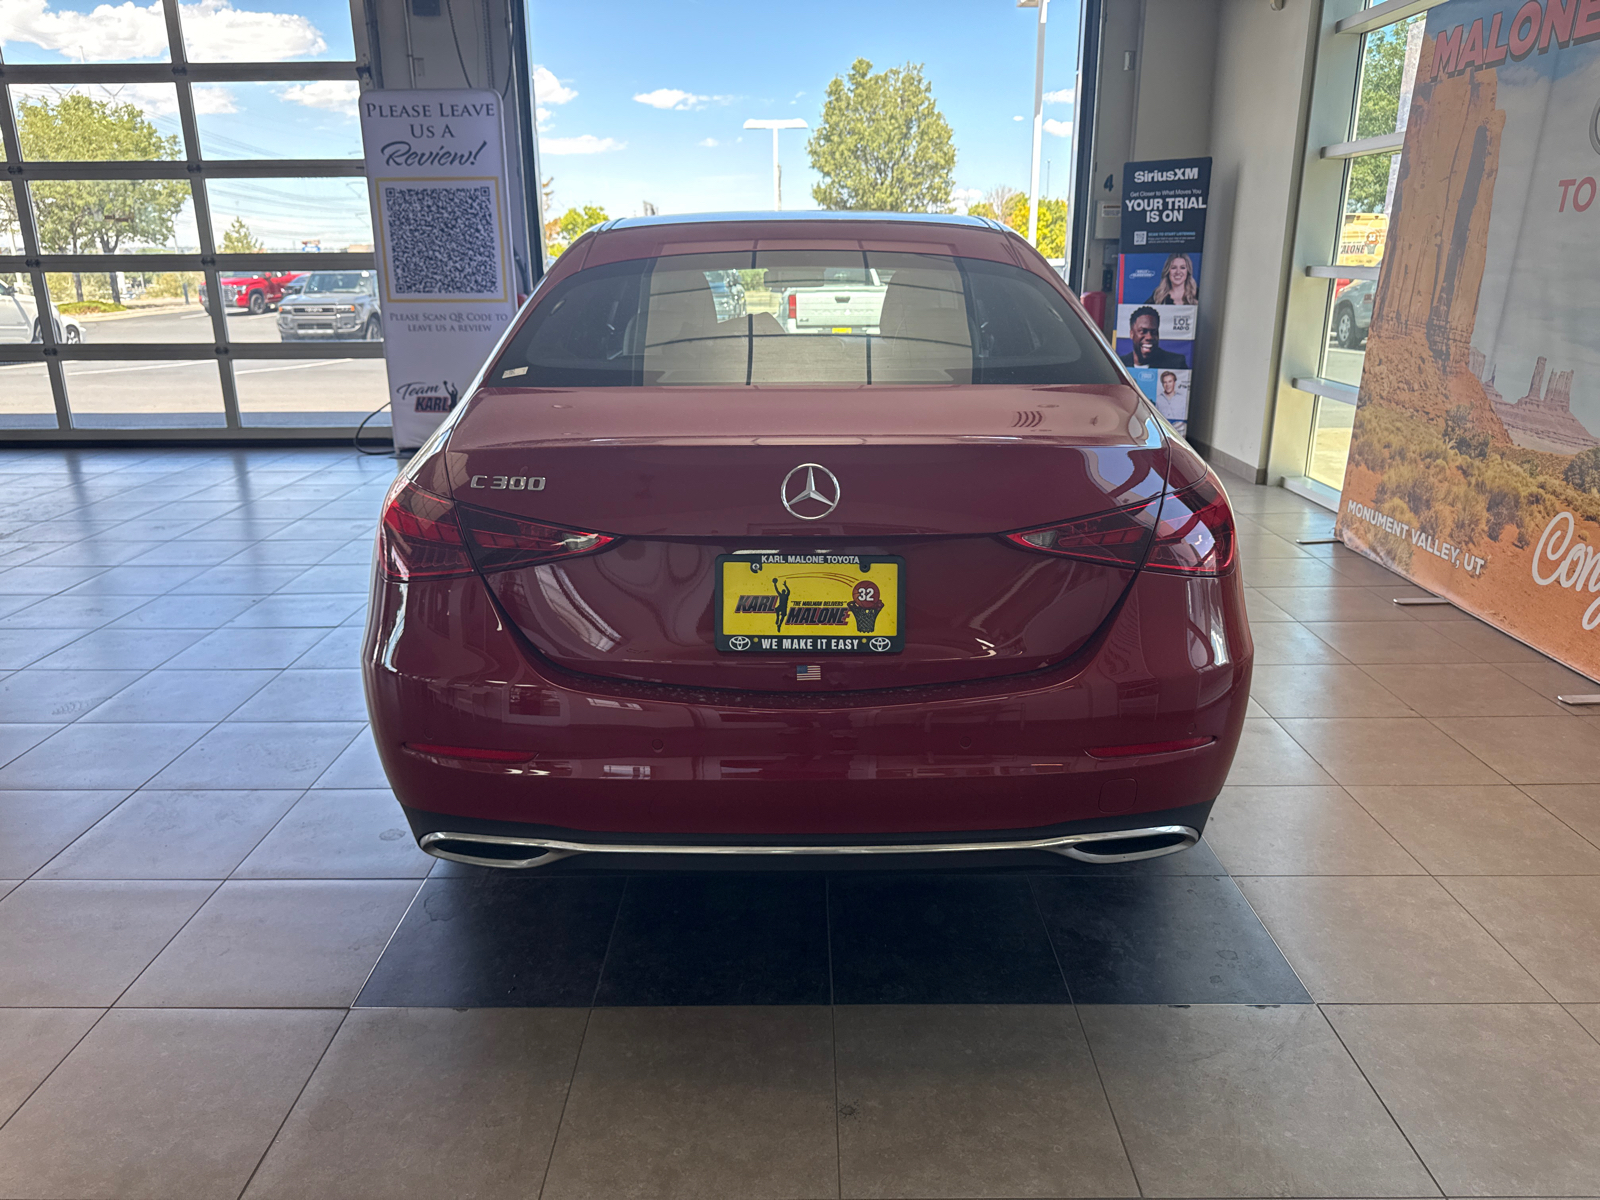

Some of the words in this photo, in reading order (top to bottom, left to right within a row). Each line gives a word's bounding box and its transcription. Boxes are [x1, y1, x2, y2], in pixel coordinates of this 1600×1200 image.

[366, 103, 432, 118] PLEASE
[439, 103, 495, 118] LEAVE
[441, 124, 456, 139] A
[380, 140, 488, 167] Review!
[1134, 167, 1199, 183] SiriusXM
[1103, 174, 1114, 192] 4
[1558, 176, 1597, 213] TO
[1125, 198, 1163, 212] YOUR
[1166, 196, 1207, 210] TRIAL
[1146, 210, 1160, 223] IS
[1162, 210, 1184, 222] ON
[1340, 244, 1365, 255] ALONE
[389, 312, 419, 321] PLEASE
[422, 312, 447, 321] SCAN
[449, 312, 464, 322] QR
[466, 312, 493, 321] CODE
[407, 324, 433, 332] LEAVE
[435, 324, 447, 332] US
[449, 324, 457, 332] A
[459, 324, 492, 332] REVIEW
[396, 381, 440, 401] Team
[415, 397, 449, 412] KARL
[470, 474, 488, 489] C
[490, 475, 546, 491] 300
[1347, 499, 1409, 540] MONUMENT
[1411, 528, 1461, 568] VALLEY,
[1463, 551, 1485, 575] UT
[761, 555, 785, 564] KARL
[788, 555, 824, 564] MALONE
[826, 555, 860, 564] TOYOTA
[858, 587, 874, 602] 32
[735, 595, 778, 613] KARL
[785, 607, 850, 626] MALONE
[761, 638, 778, 650] WE
[782, 638, 814, 650] MAKE
[818, 638, 828, 650] IT
[831, 638, 859, 650] EASY
